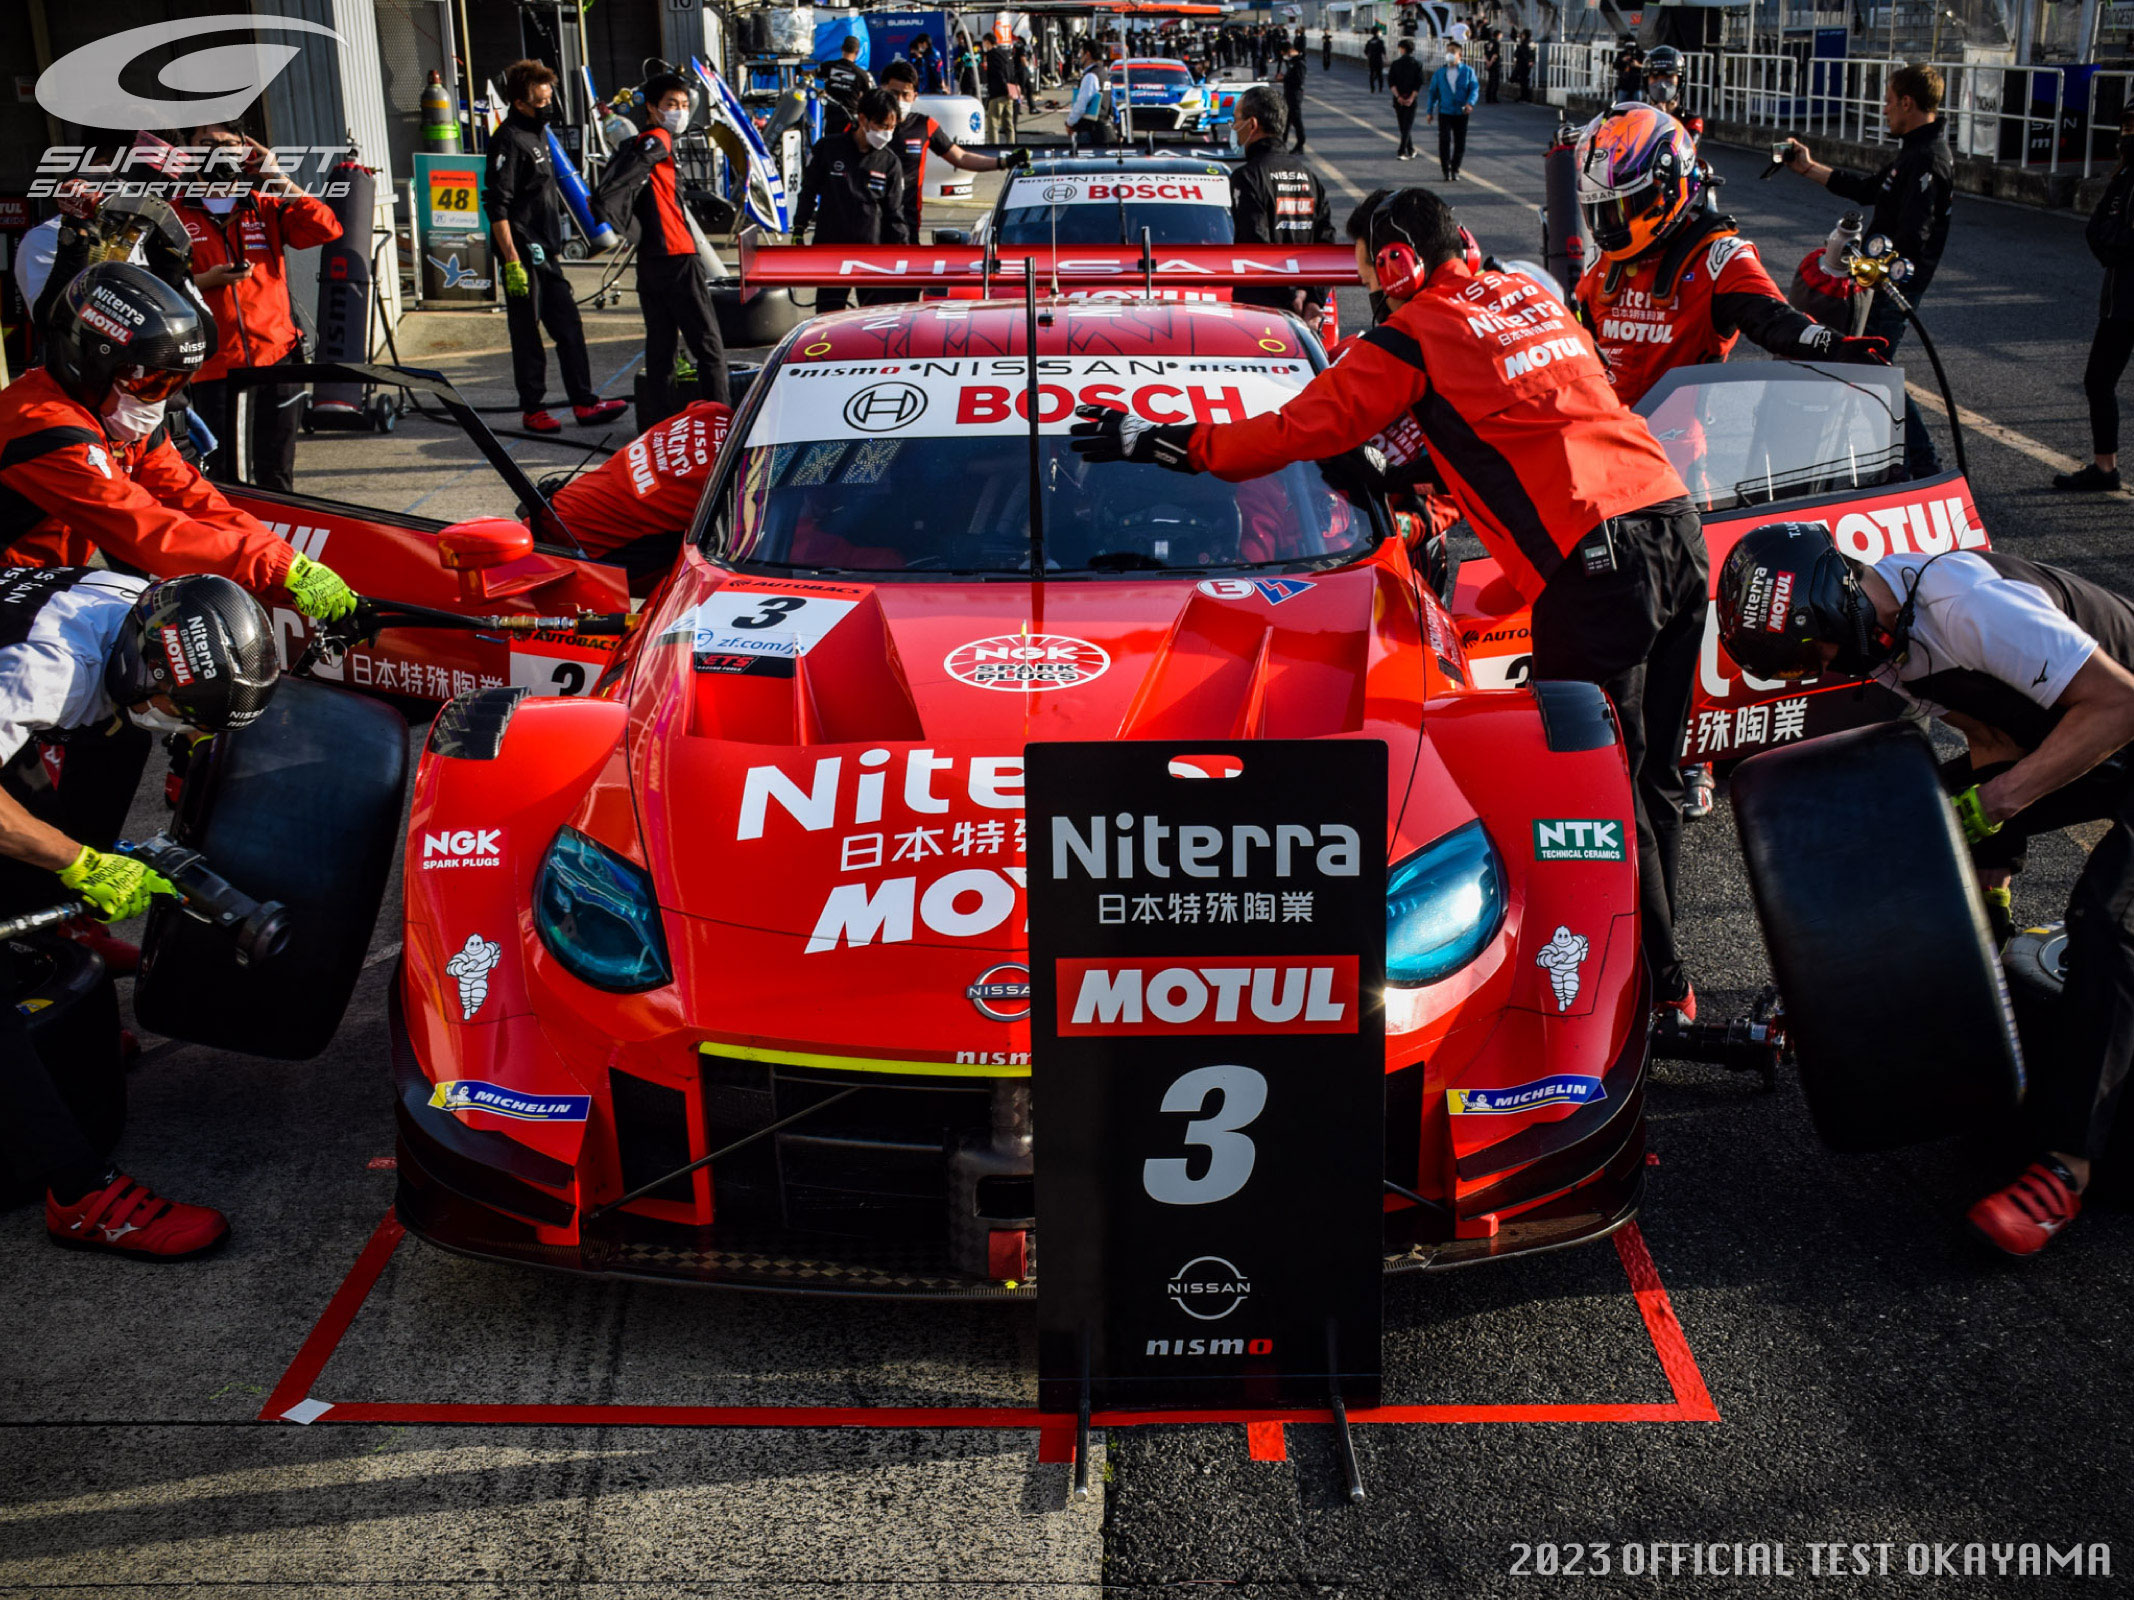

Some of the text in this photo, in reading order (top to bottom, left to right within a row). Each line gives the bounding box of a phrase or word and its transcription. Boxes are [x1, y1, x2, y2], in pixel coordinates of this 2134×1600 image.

[1270, 171, 1309, 182] NISSAN
[437, 188, 470, 211] 48
[1088, 185, 1204, 200] BOSCH
[839, 257, 1300, 275] NISSAN
[91, 285, 147, 327] Niterra
[81, 307, 133, 344] MOTUL
[1602, 319, 1674, 344] MOTUL
[800, 359, 1290, 379] nismo NISSAN nismo
[1504, 336, 1589, 380] MOTUL
[956, 384, 1249, 425] BOSCH
[627, 440, 656, 495] OTUL
[1832, 496, 1987, 566] OTUL
[755, 581, 861, 594] AUTOBACS
[1742, 566, 1769, 630] Niterra
[731, 596, 807, 630] 3
[1768, 573, 1793, 632] MOTUL
[163, 628, 193, 684] MOTUL
[186, 615, 217, 681] Niterra
[974, 646, 1079, 661] NGK
[703, 655, 754, 668] ETS
[976, 663, 1078, 672] SPARK
[974, 672, 1079, 681] PLUGS
[423, 828, 501, 857] NGK
[1051, 811, 1361, 880] Niterra
[1538, 821, 1619, 848] NTK
[422, 857, 500, 870] SPARK PLUGS
[1541, 850, 1621, 859] TECHNICAL CERAMICS
[1098, 890, 1315, 925] 日本特殊陶業
[968, 984, 1030, 999] NISSA
[1071, 967, 1346, 1024] MOTUL
[956, 1049, 1032, 1067] nism
[473, 1089, 572, 1114] MICHELIN
[1493, 1082, 1588, 1107] MICHELIN
[1142, 1063, 1269, 1206] 3
[1166, 1281, 1251, 1294] NISSAN
[1145, 1337, 1274, 1356] nismo
